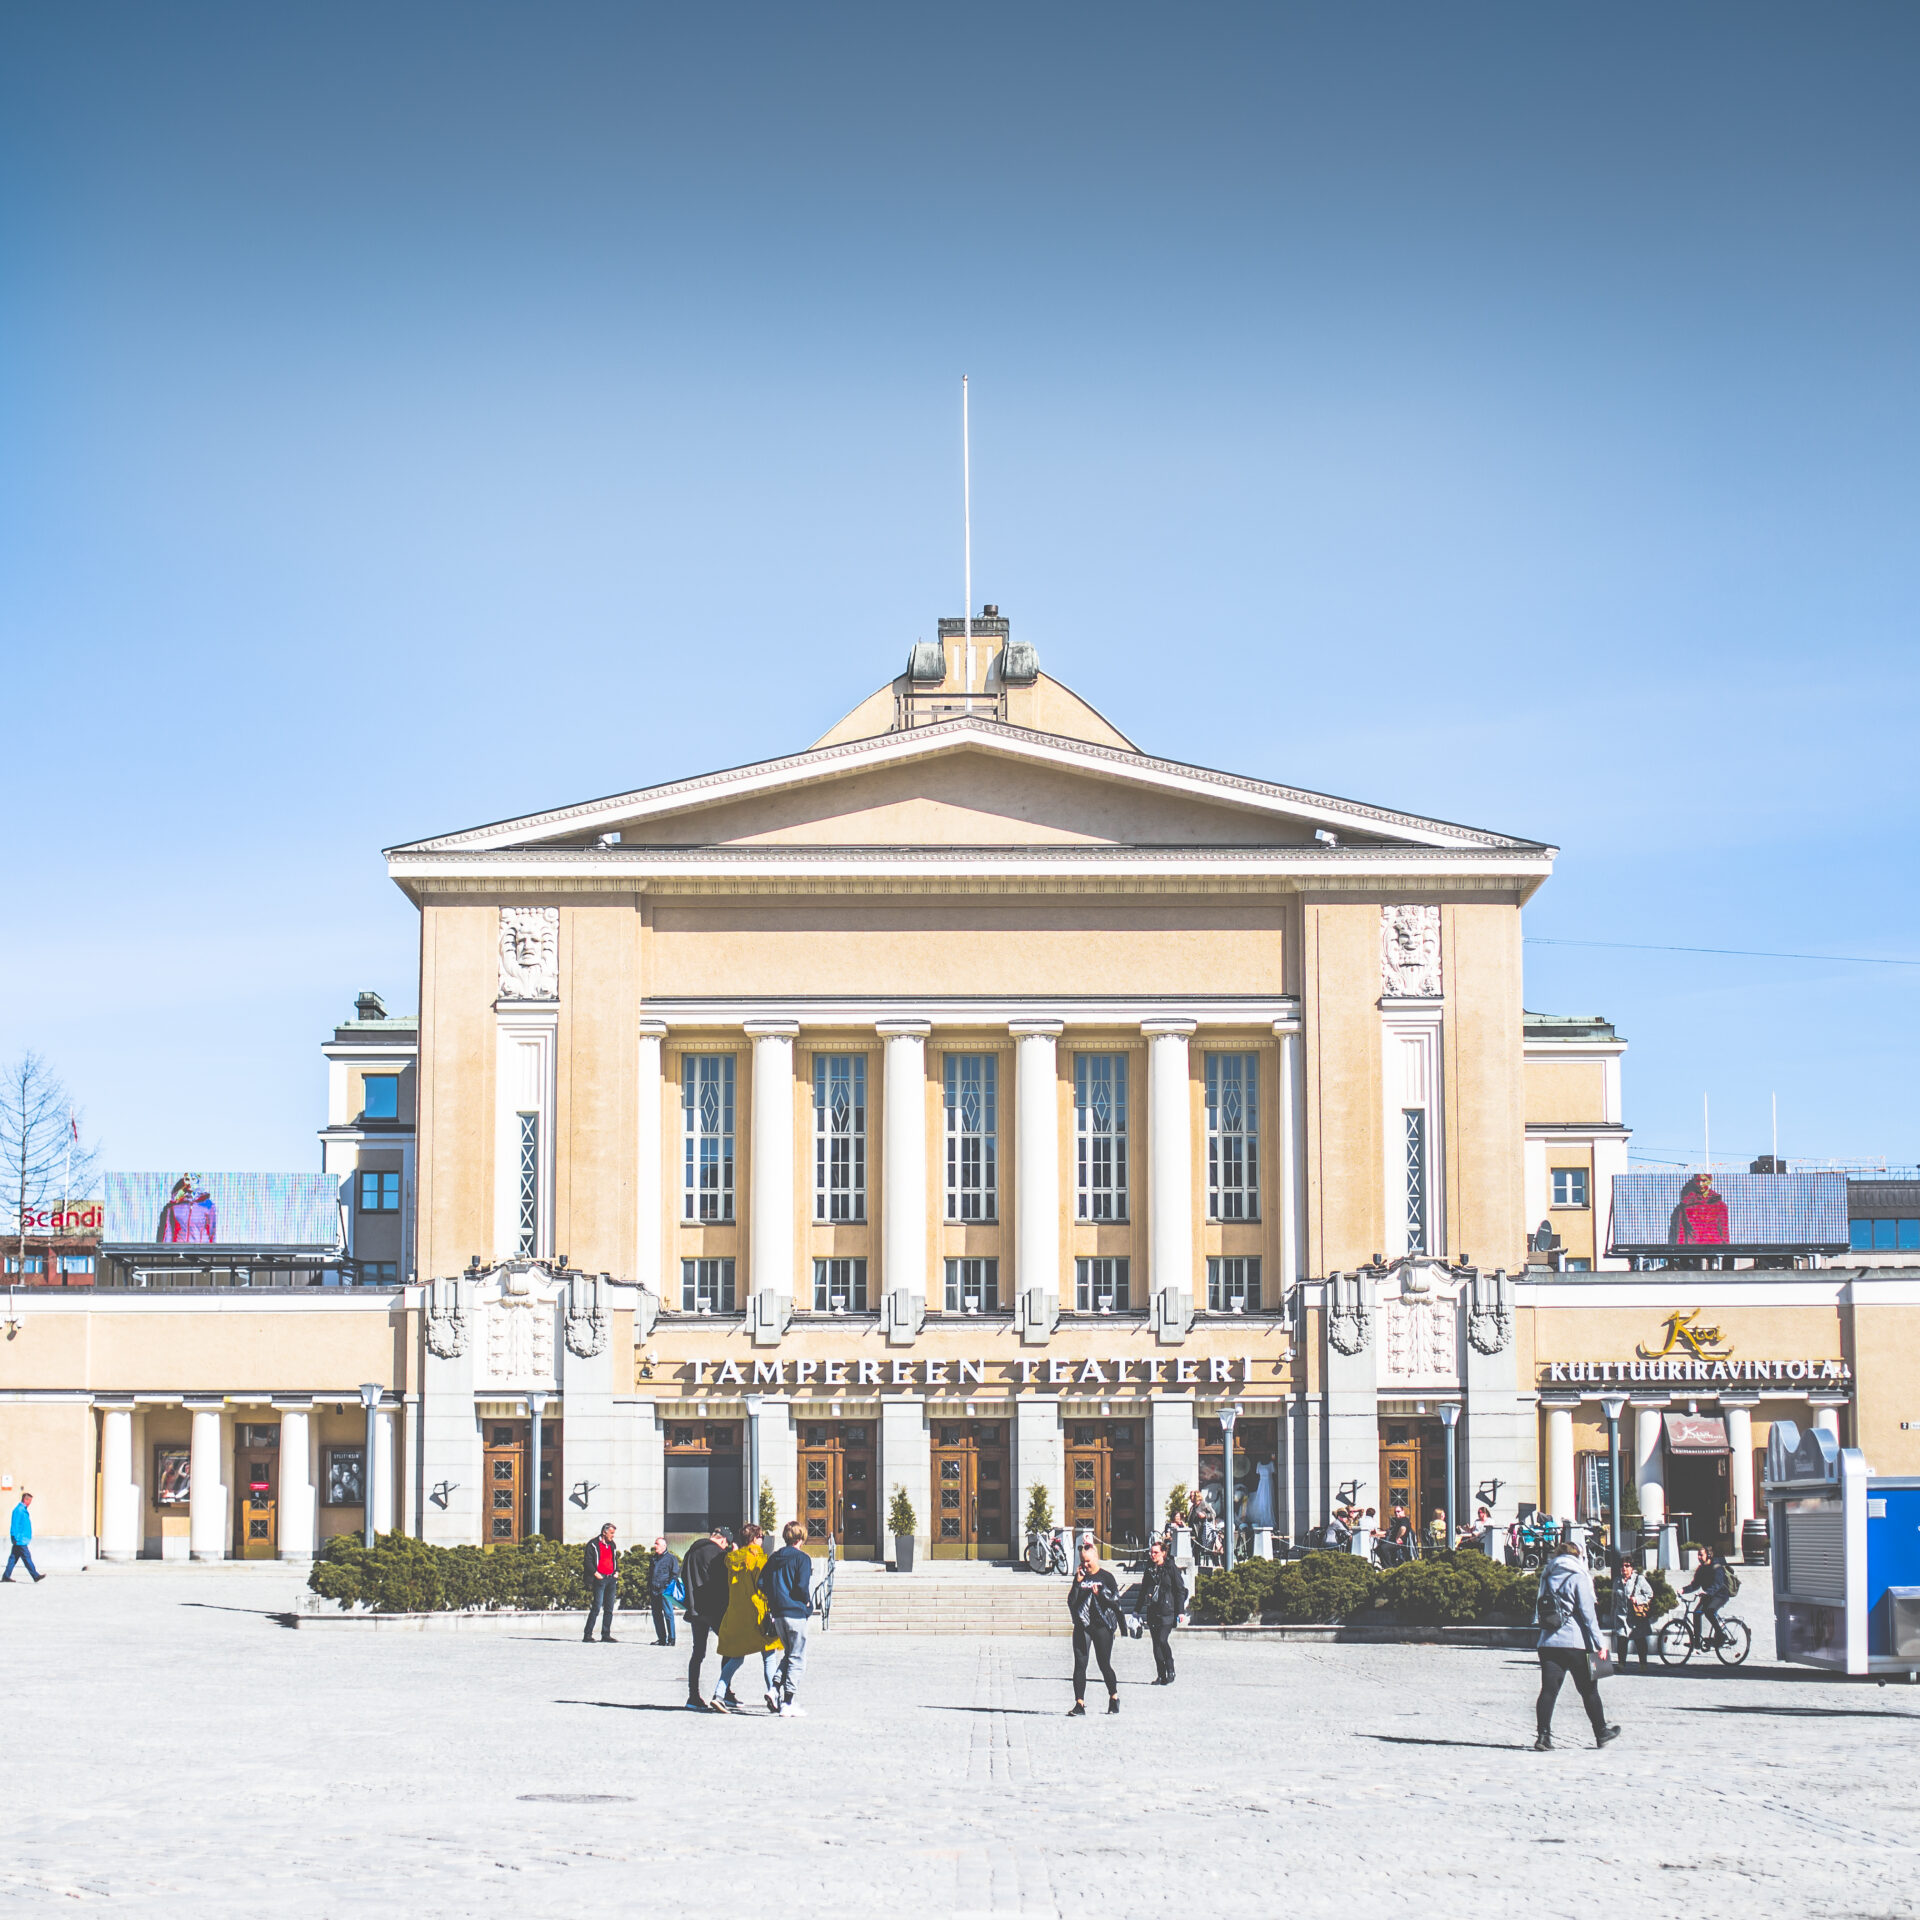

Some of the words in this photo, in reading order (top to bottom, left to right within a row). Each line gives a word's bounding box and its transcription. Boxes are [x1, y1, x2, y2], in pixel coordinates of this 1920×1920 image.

[686, 1358, 985, 1385] TAMPEREEN
[1014, 1357, 1252, 1383] TEATTERI
[1551, 1360, 1837, 1381] KULTTUURIRAVINTOLA
